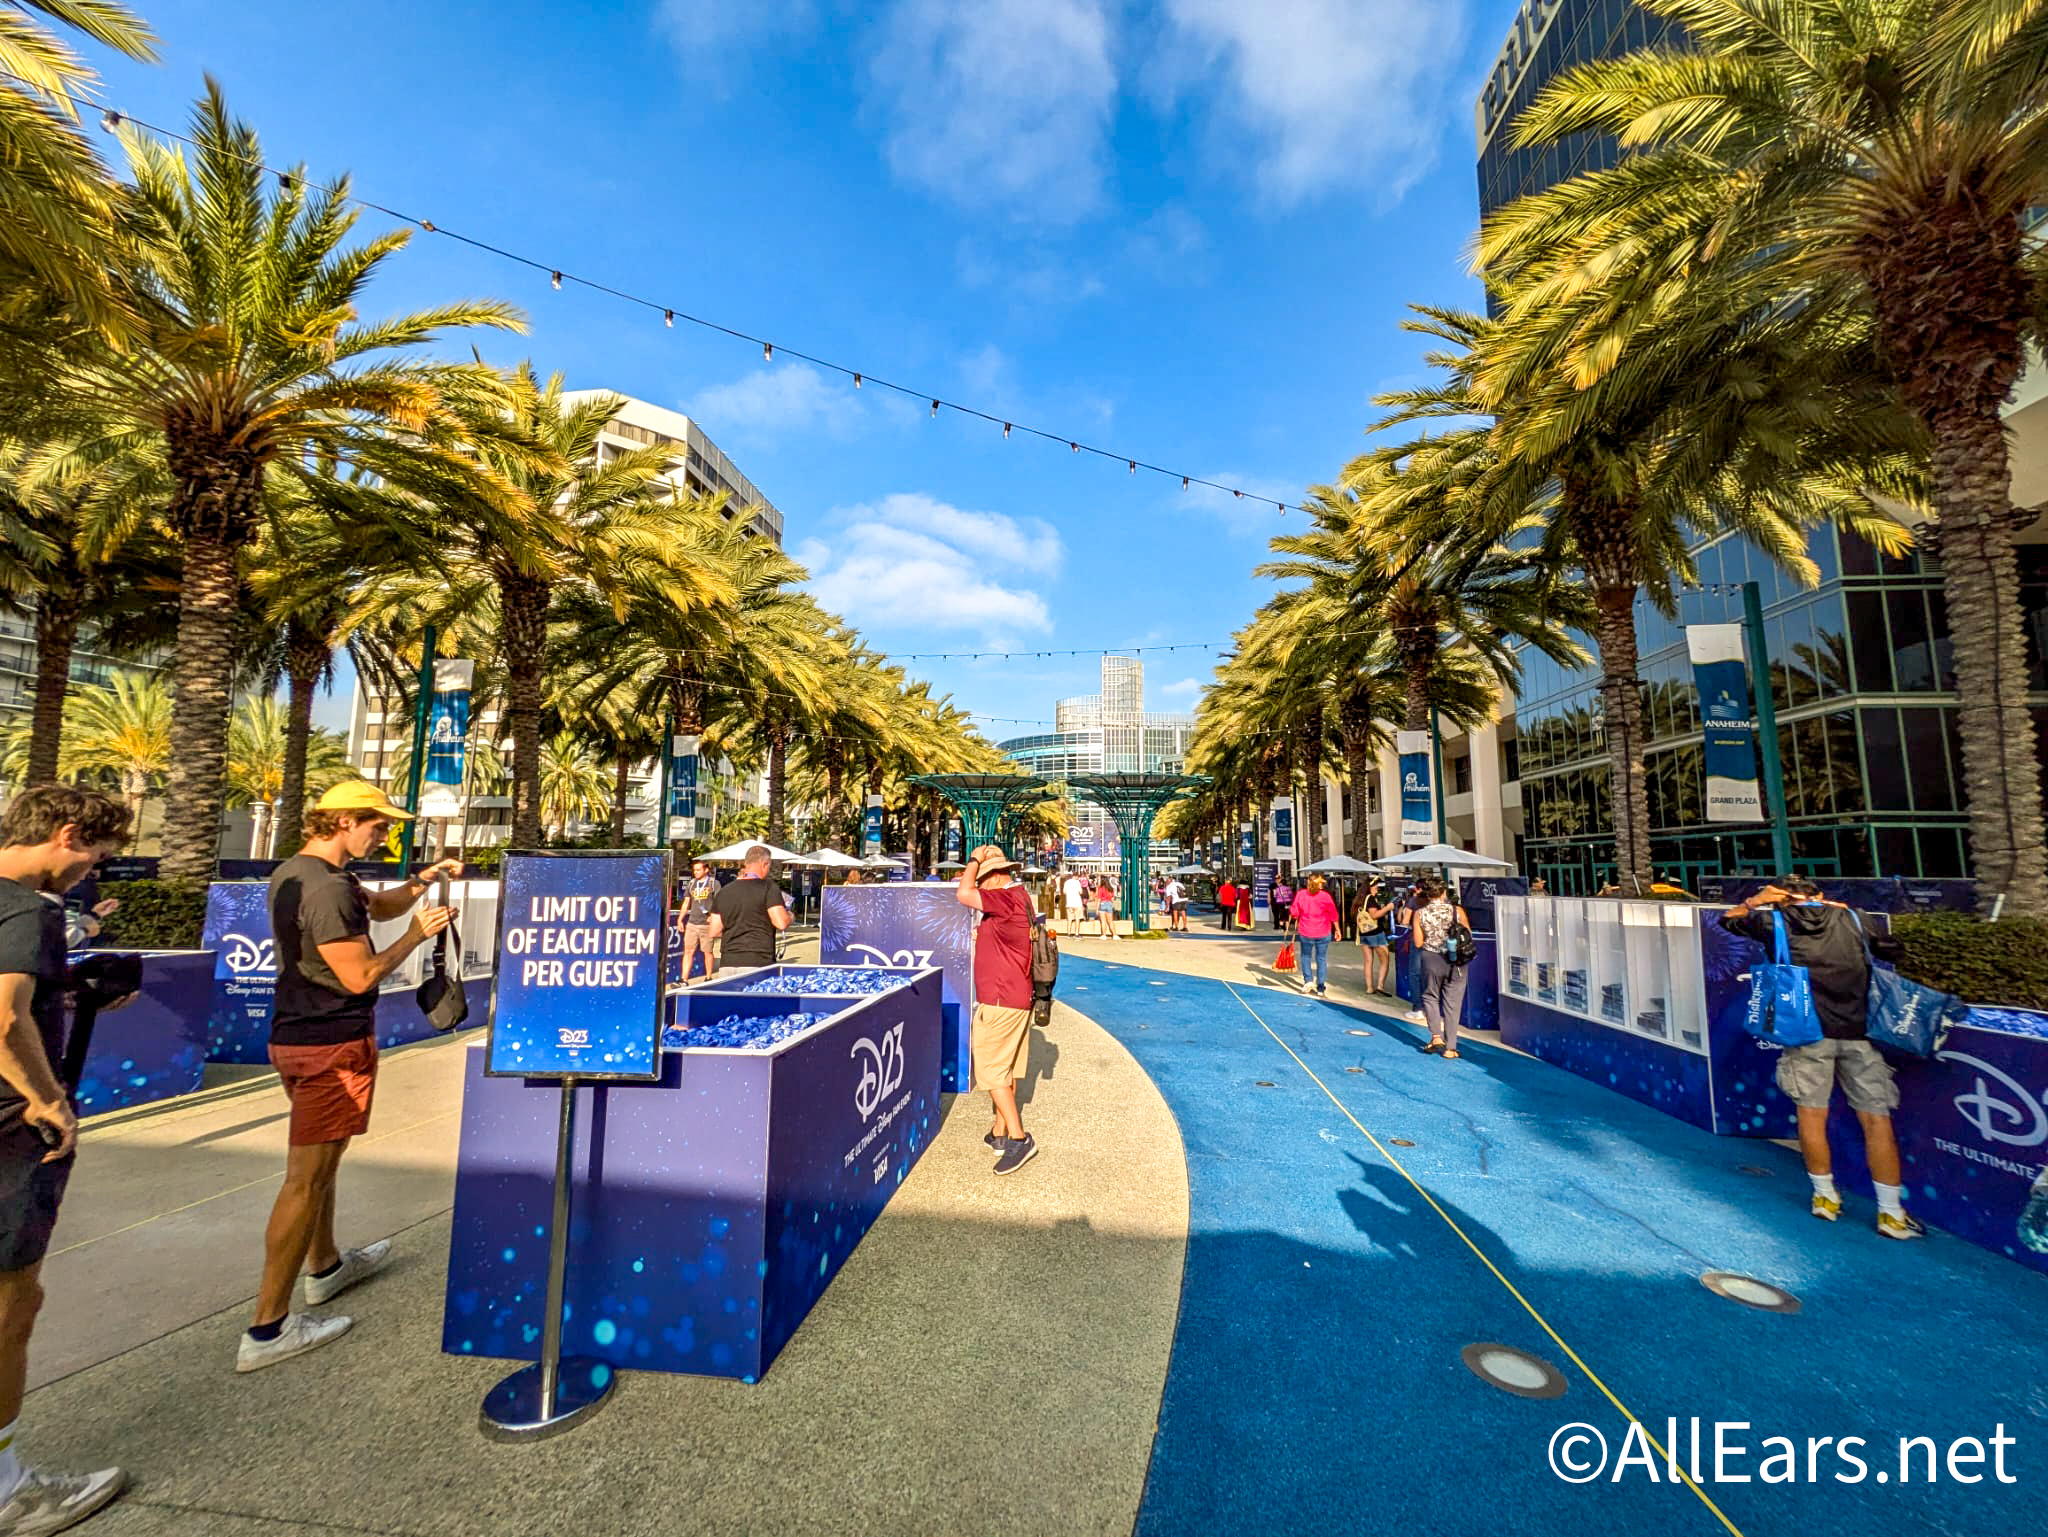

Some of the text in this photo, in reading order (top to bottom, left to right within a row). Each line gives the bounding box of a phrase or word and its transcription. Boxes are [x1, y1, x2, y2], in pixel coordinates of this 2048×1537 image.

[1705, 720, 1750, 728] ANAHEIM
[1067, 825, 1094, 838] D23
[531, 897, 637, 922] LIMIT OF 1
[507, 928, 655, 954] OF EACH ITEM
[667, 926, 681, 948] 23
[222, 934, 277, 972] D2
[523, 960, 639, 987] PER GUEST
[247, 1009, 266, 1017] VISA
[558, 1028, 588, 1043] D23
[851, 1021, 904, 1123] D23
[844, 1148, 855, 1168] THE
[855, 1125, 877, 1156] ULTIMATE
[877, 1112, 893, 1133] Disney
[874, 1155, 888, 1184] VISA
[1934, 1137, 2036, 1180] THE ULTIMATE
